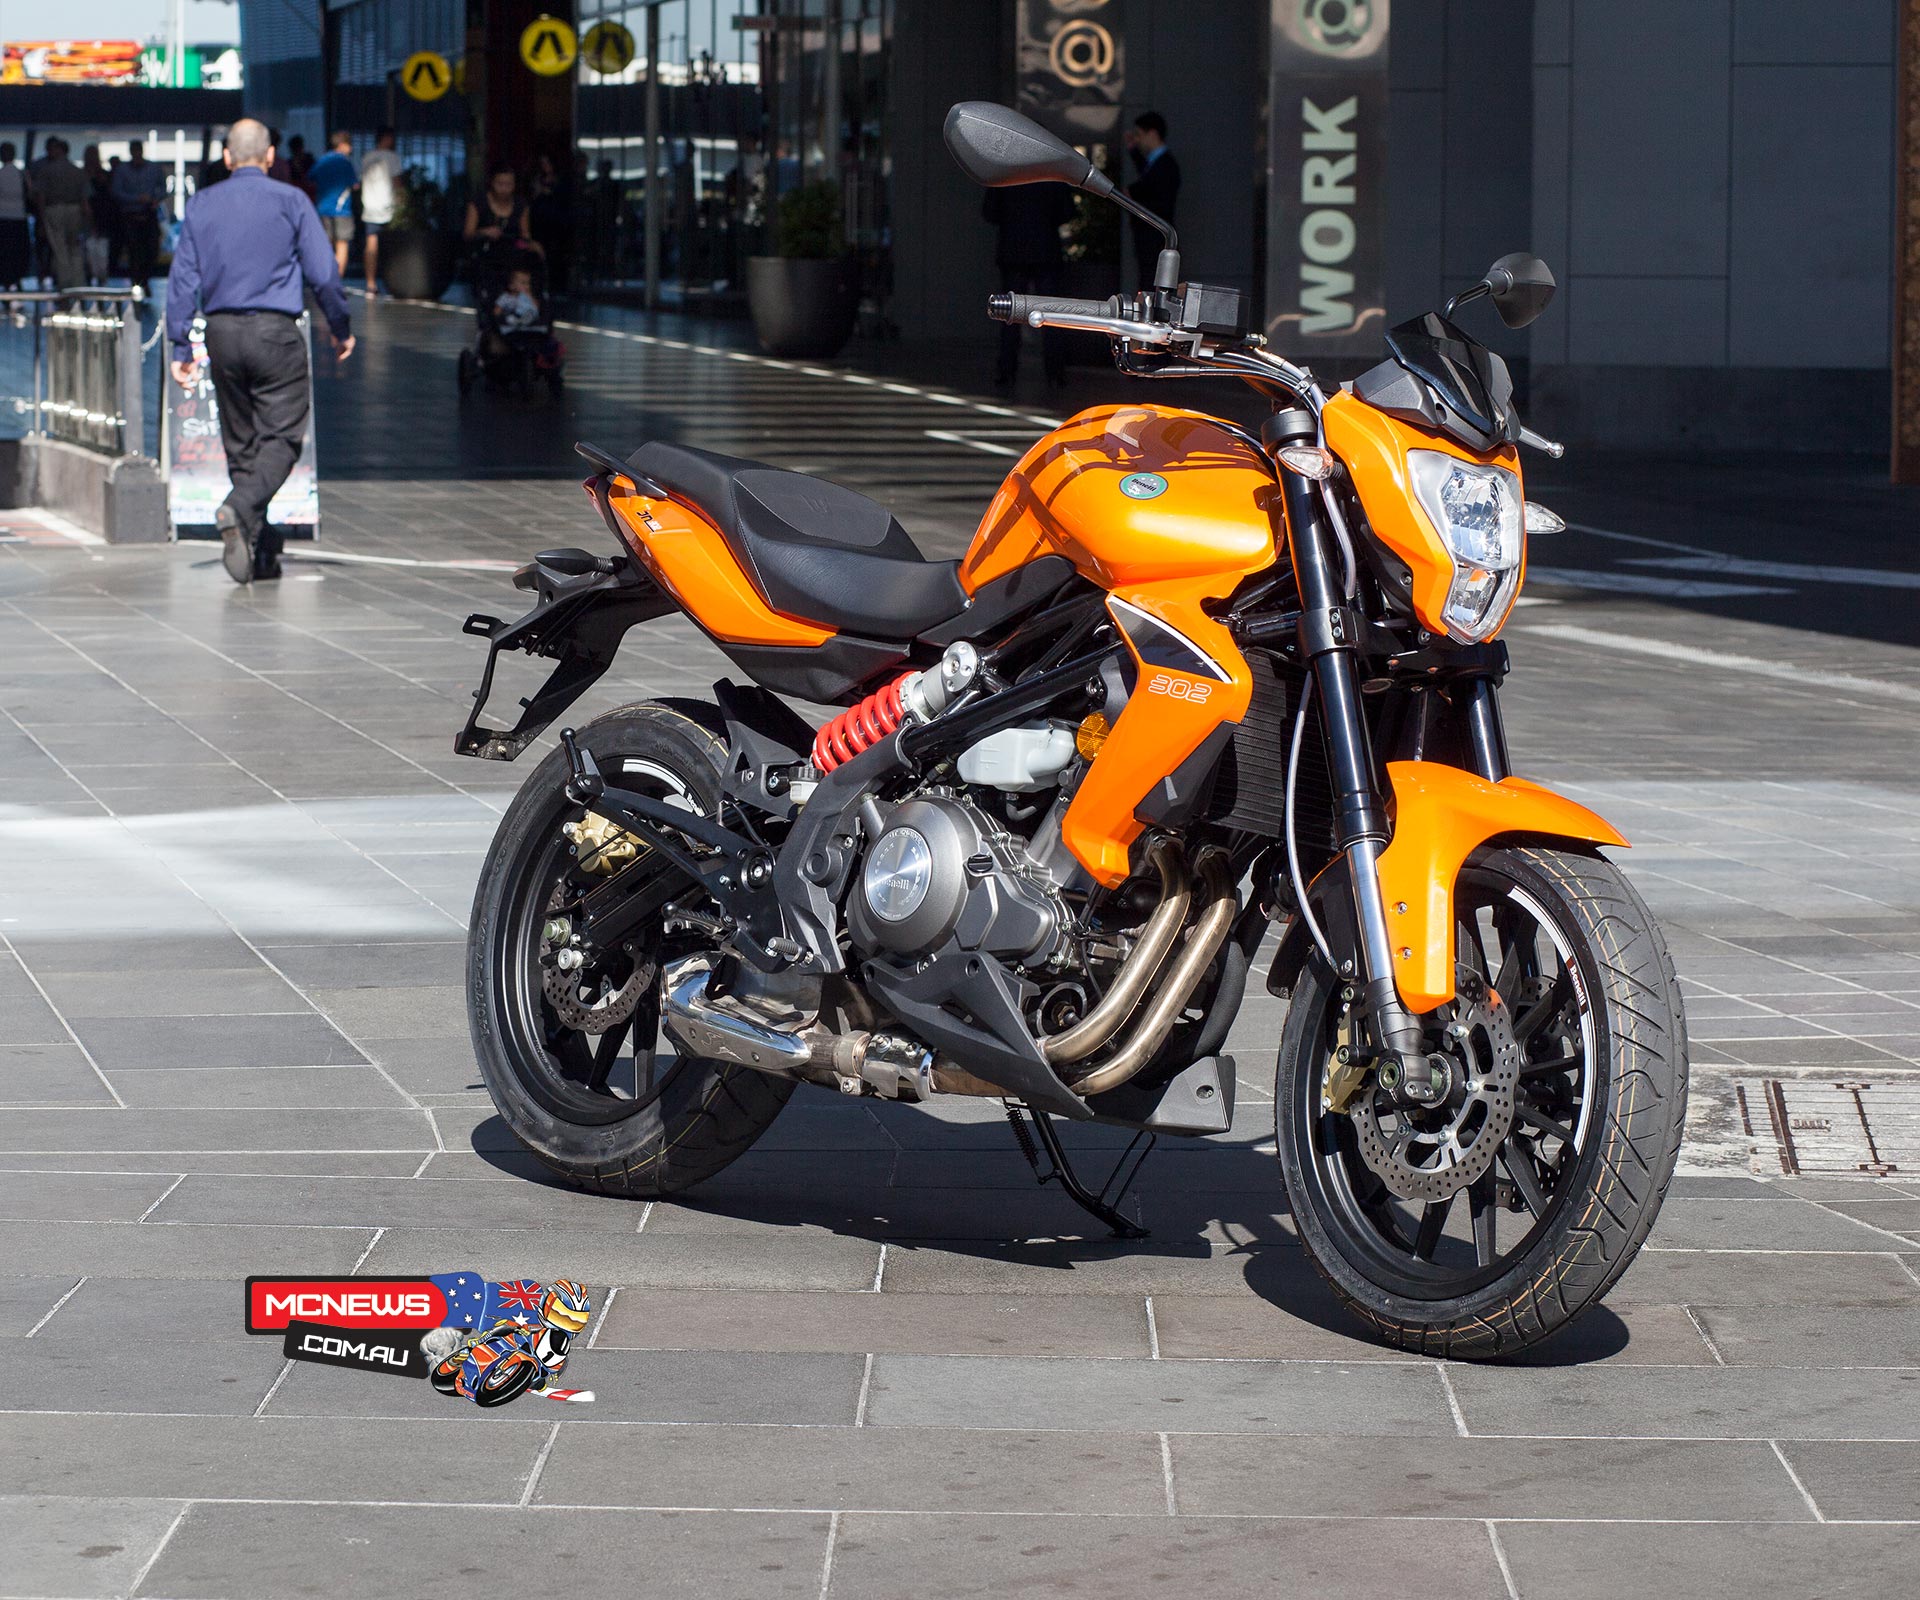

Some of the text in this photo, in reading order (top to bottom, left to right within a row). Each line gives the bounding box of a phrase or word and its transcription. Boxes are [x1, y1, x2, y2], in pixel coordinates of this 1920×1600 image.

[1049, 19, 1114, 87] @
[1300, 96, 1357, 334] WORK
[1131, 478, 1157, 492] Benelli
[1148, 674, 1212, 704] 302
[1570, 964, 1587, 1006] Benelli
